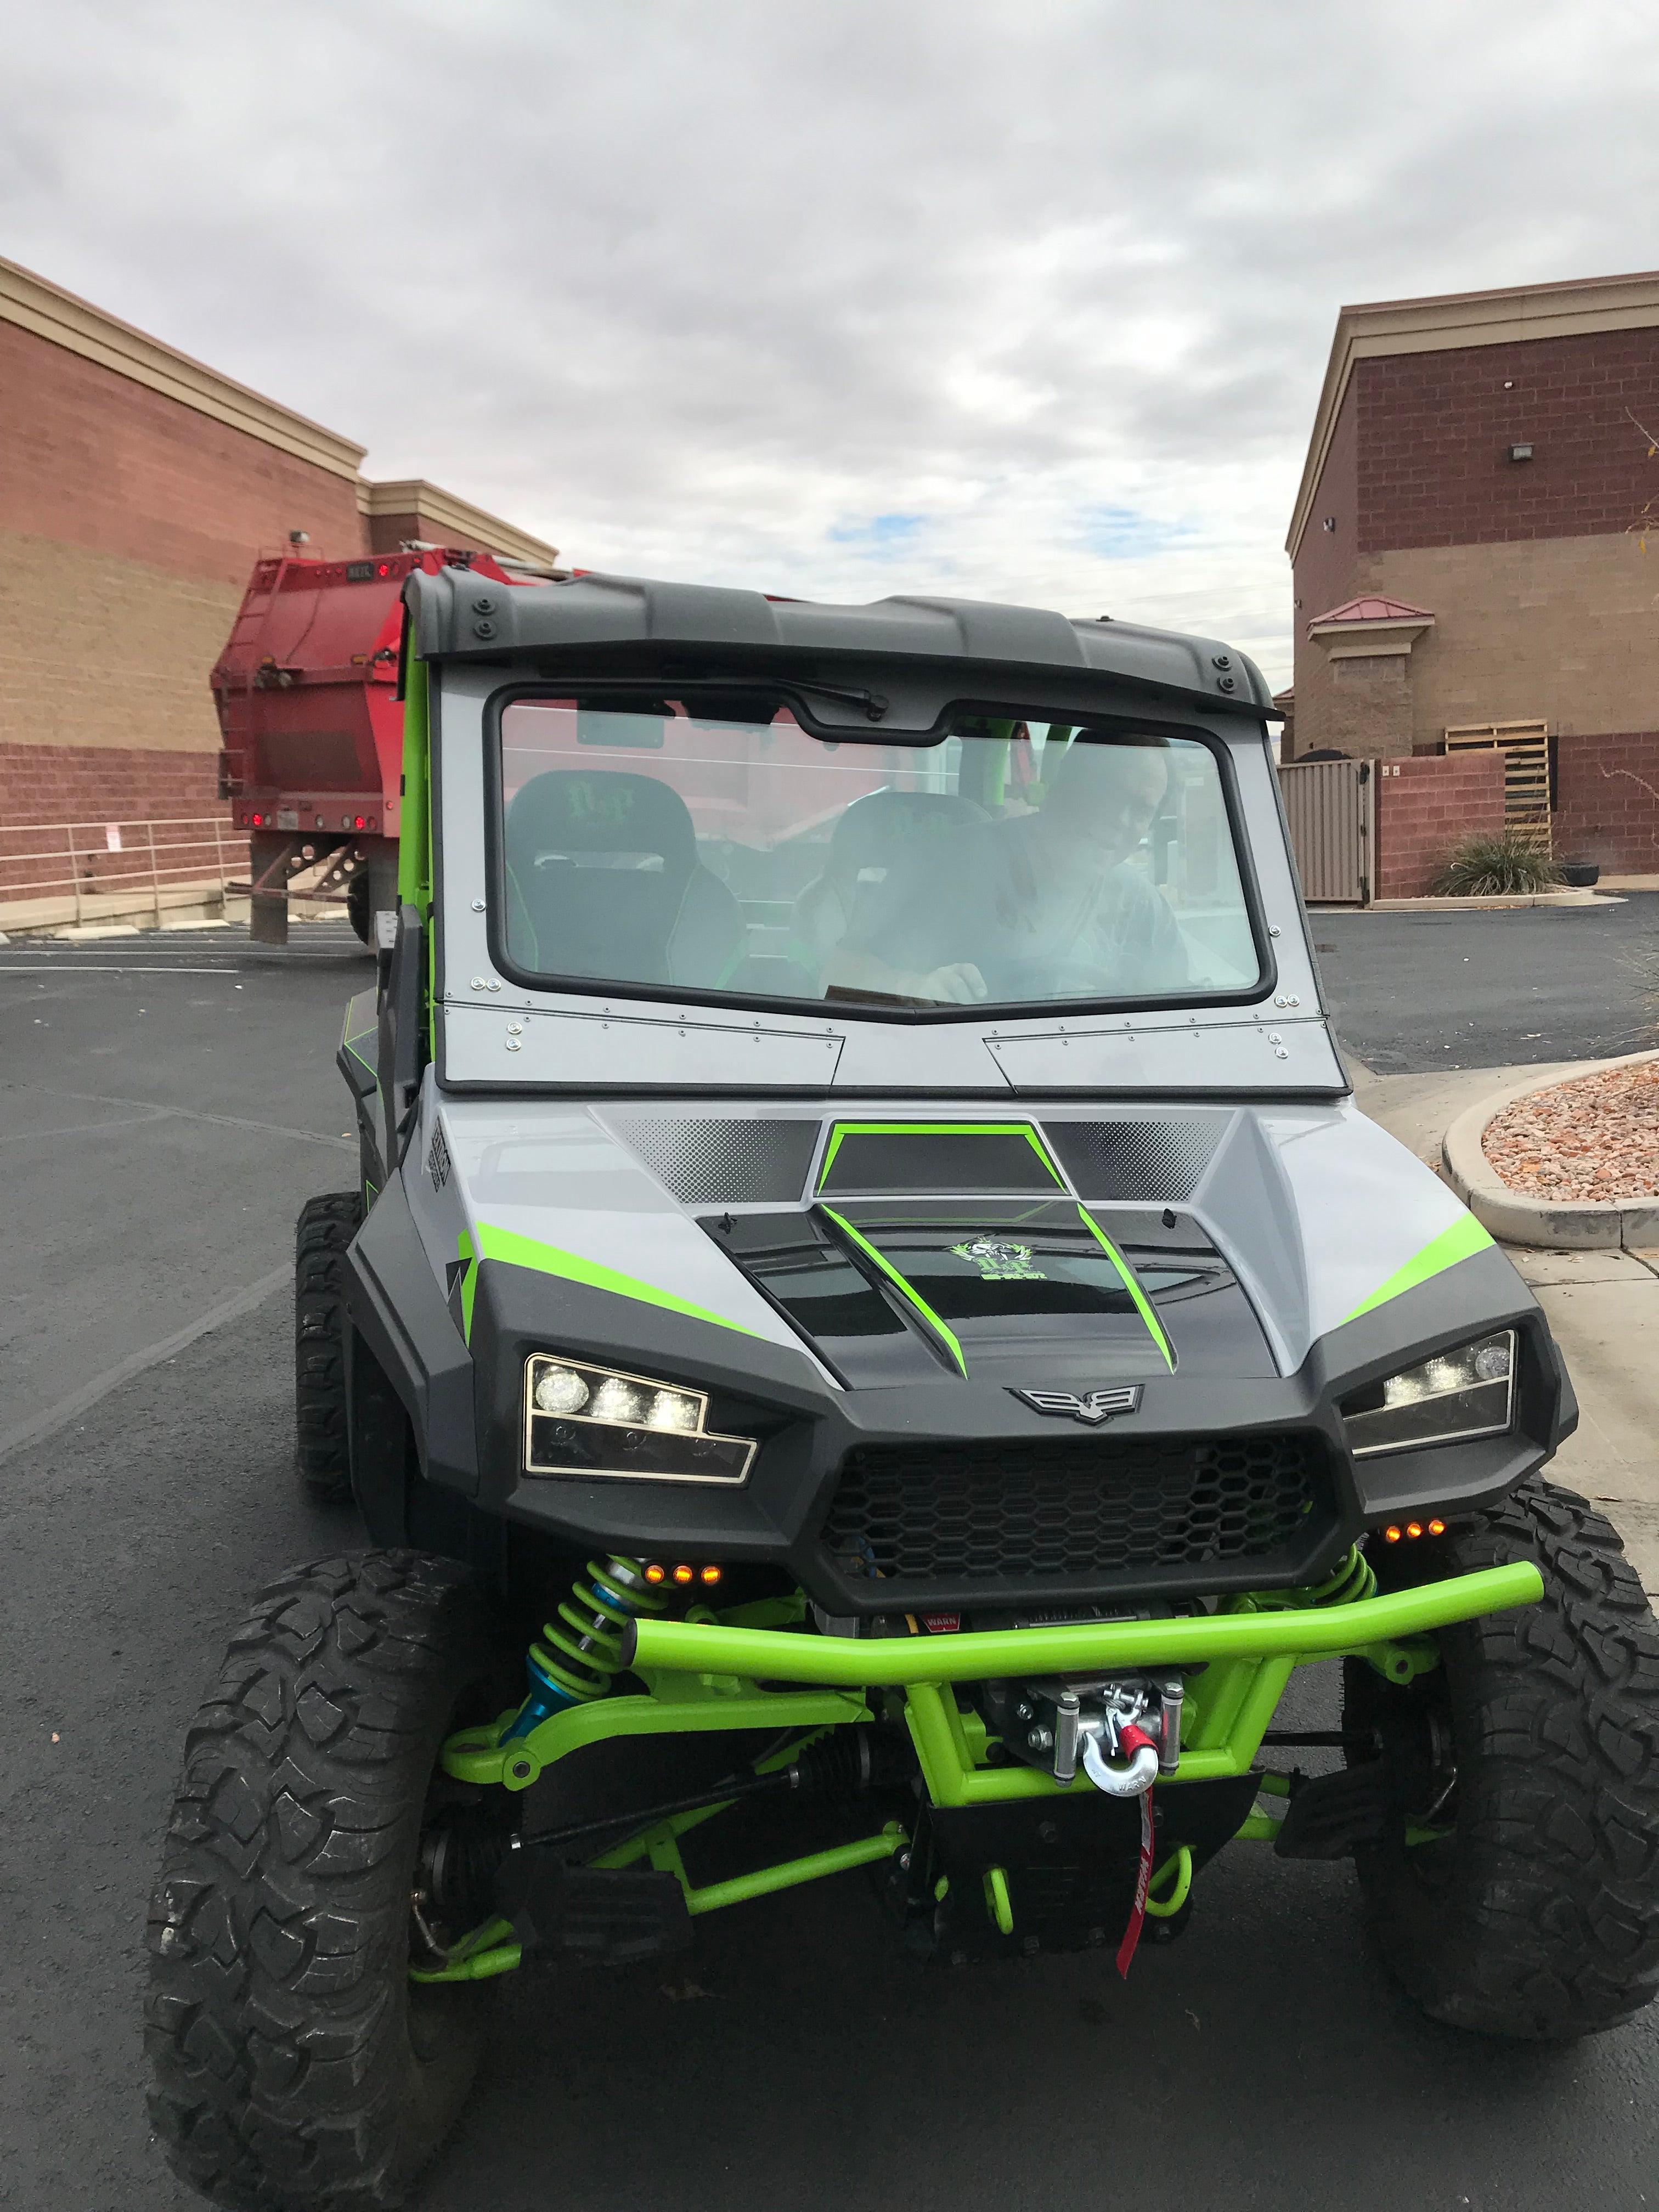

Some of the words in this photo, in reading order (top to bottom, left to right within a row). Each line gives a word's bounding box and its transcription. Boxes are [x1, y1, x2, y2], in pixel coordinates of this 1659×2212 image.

[927, 1617, 956, 1626] WARN
[1119, 1776, 1147, 1791] WARN
[1135, 1856, 1149, 1915] WARN
